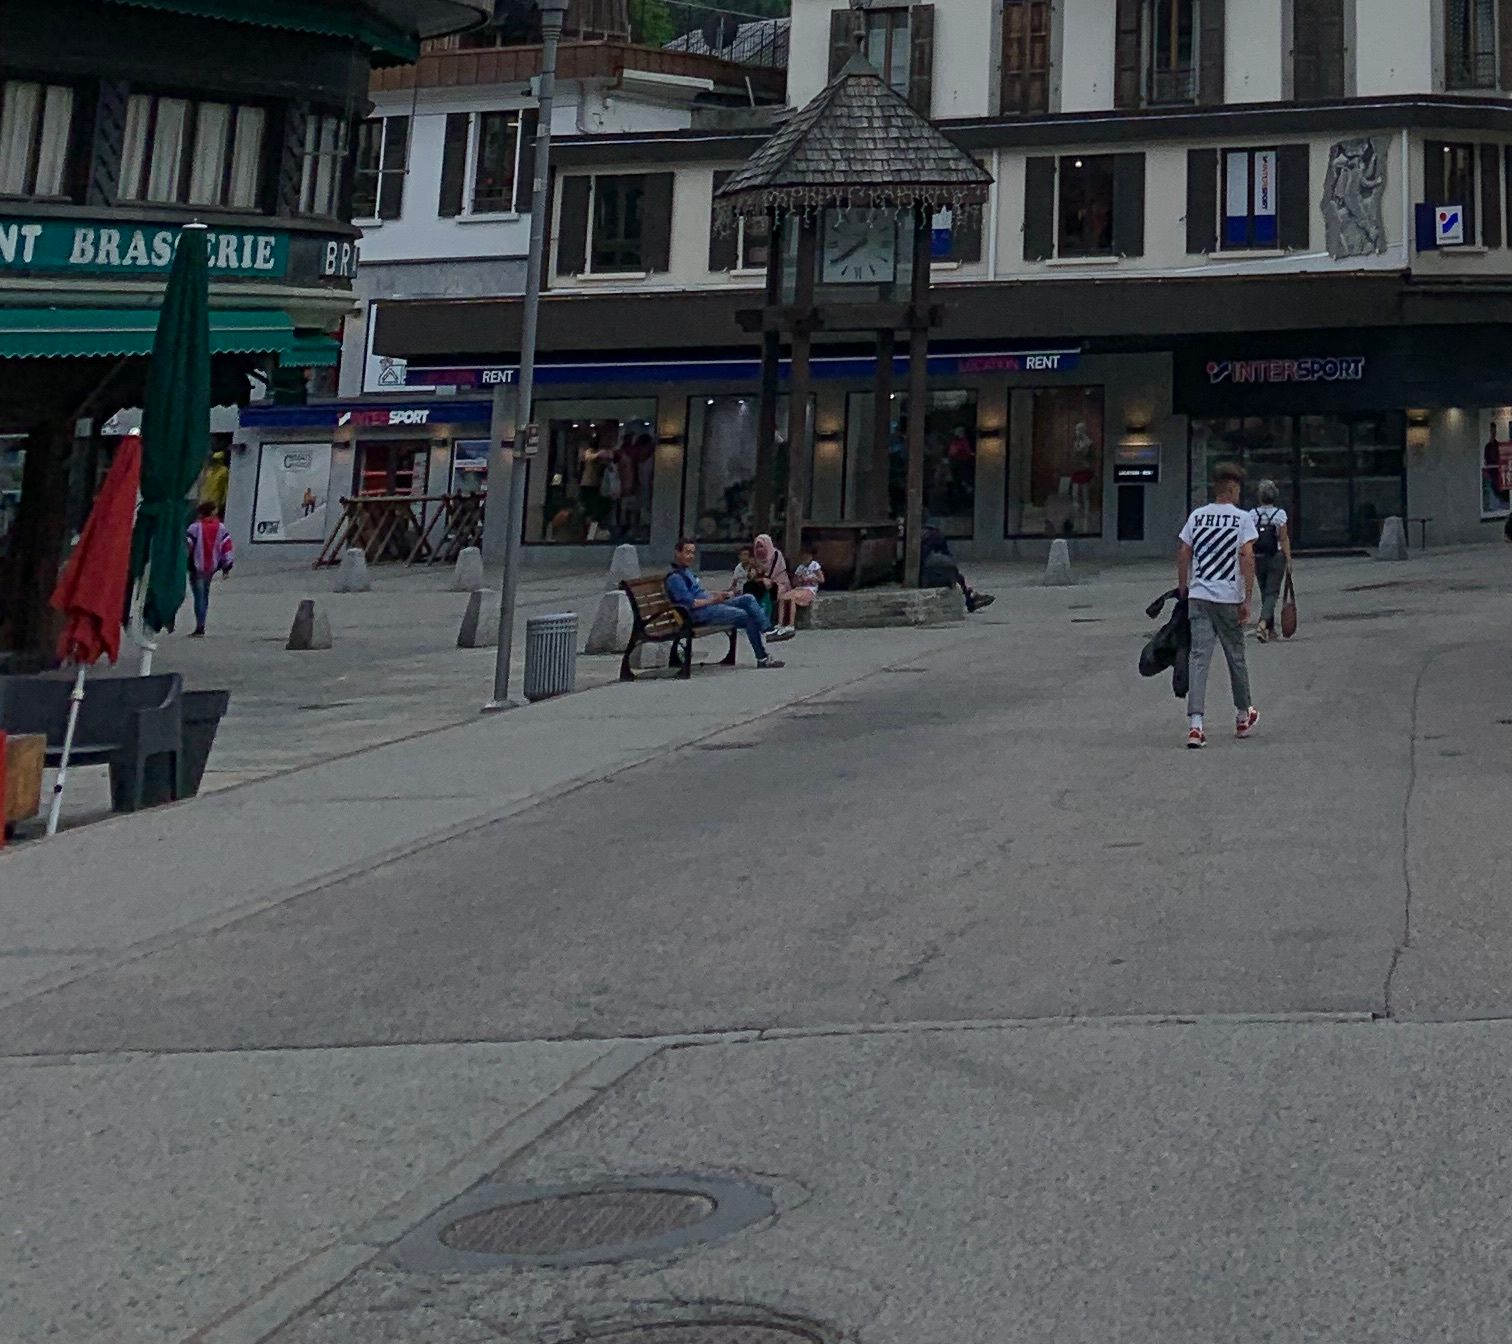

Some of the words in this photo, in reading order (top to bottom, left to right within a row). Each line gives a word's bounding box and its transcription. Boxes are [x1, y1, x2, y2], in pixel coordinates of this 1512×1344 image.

[1026, 355, 1060, 370] RENT
[482, 370, 514, 384] RENT
[1232, 357, 1365, 383] INTERSPORT
[1194, 514, 1240, 528] WHITE
